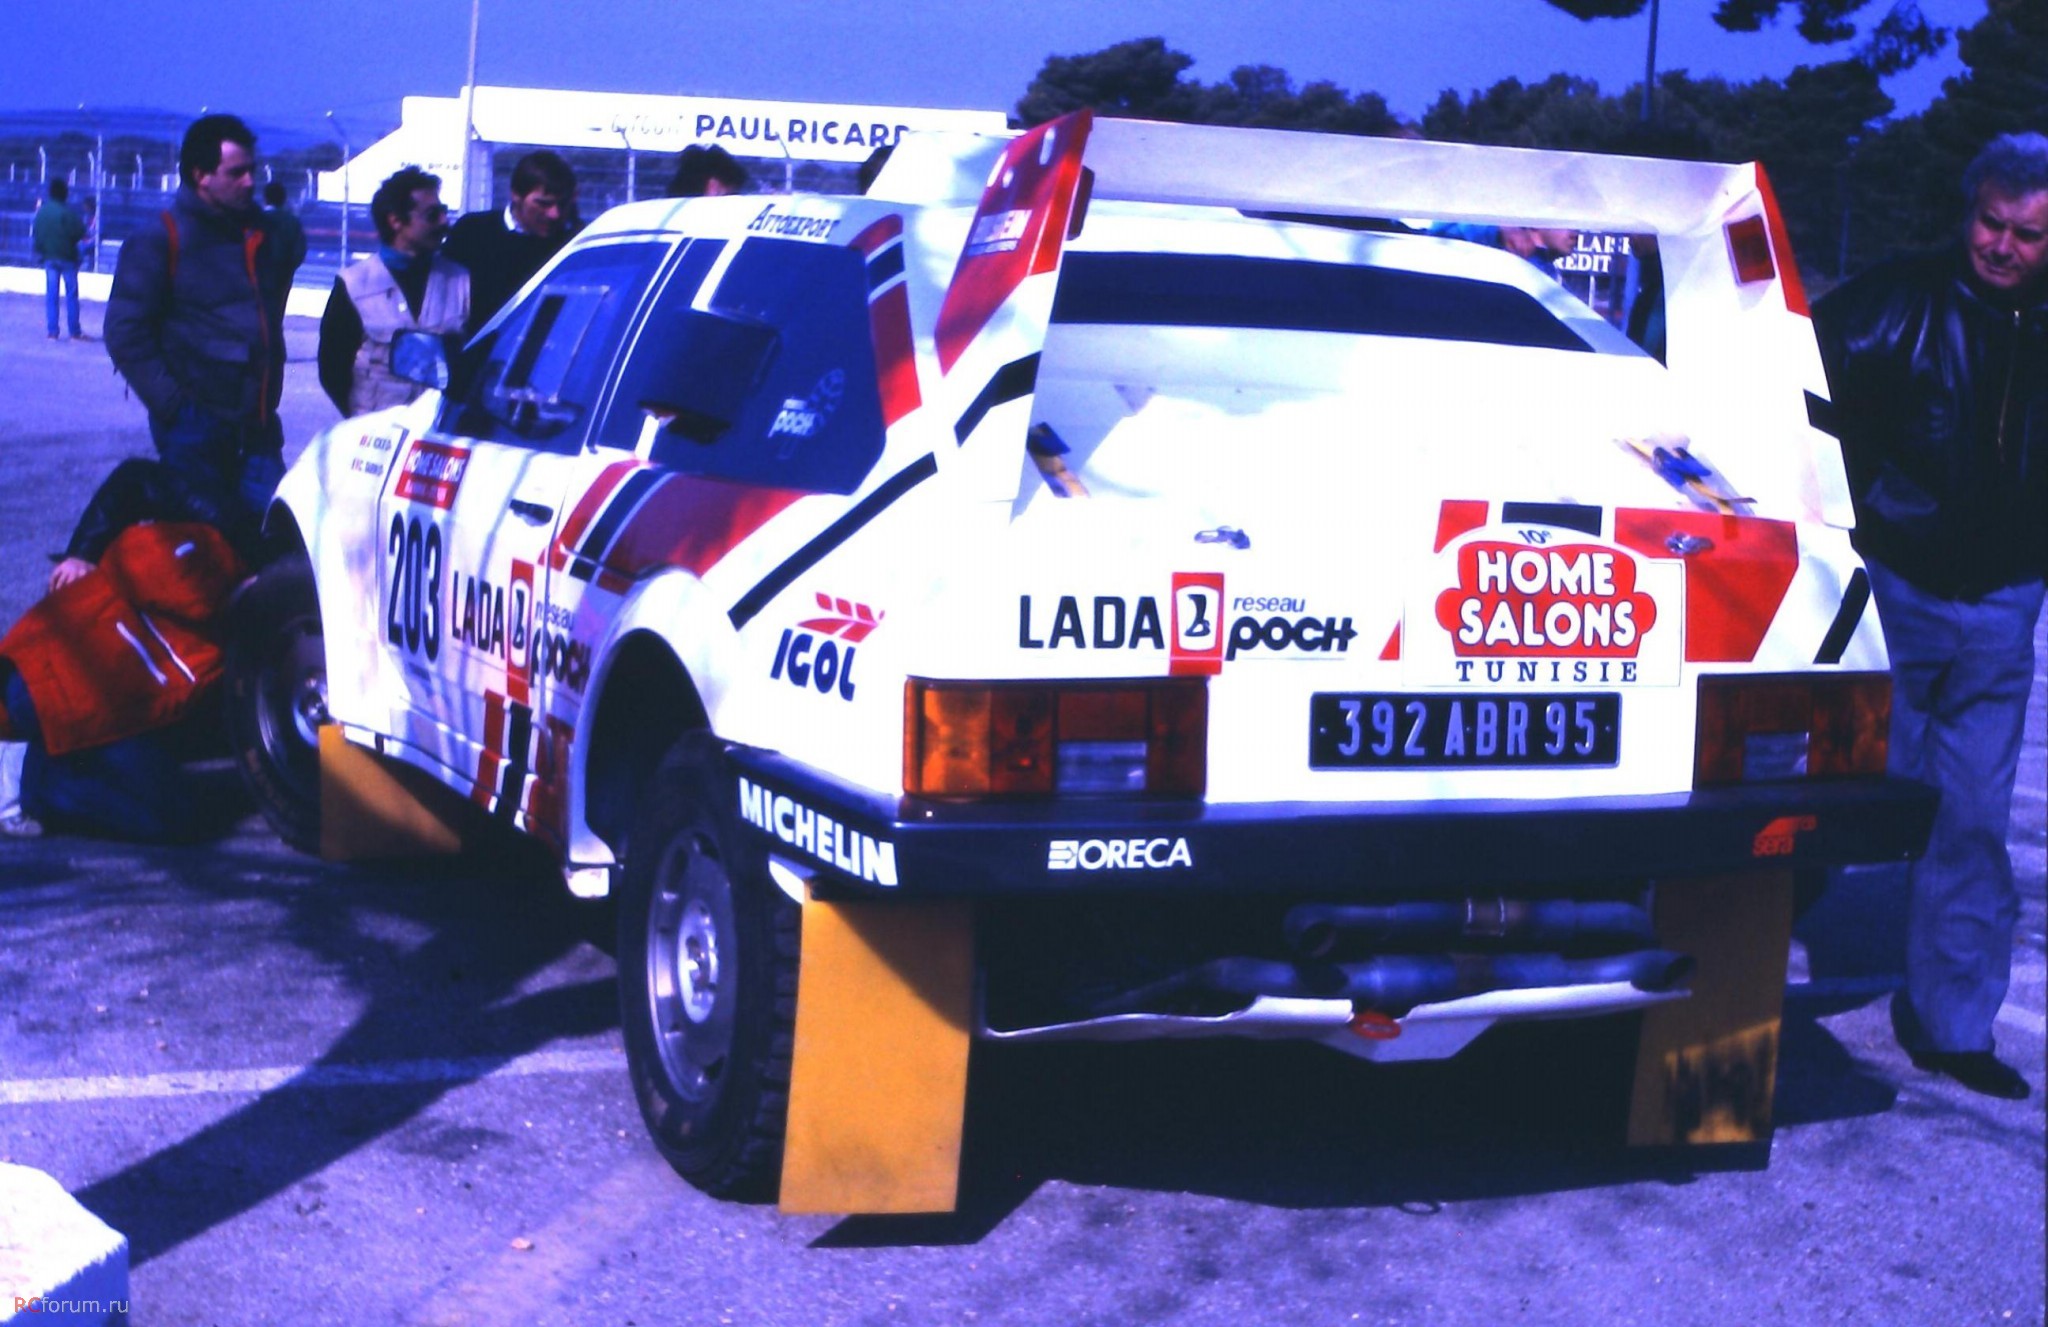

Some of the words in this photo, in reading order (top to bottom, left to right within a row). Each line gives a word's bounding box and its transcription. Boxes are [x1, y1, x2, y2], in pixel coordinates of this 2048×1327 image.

[695, 114, 779, 140] PAUL
[388, 510, 442, 661] 203
[1477, 550, 1616, 596] HOME
[452, 570, 505, 660] LADA
[535, 600, 575, 632] rseau
[1019, 595, 1165, 649] LADA
[1233, 597, 1305, 612] reseau
[1458, 598, 1636, 647] SALONS
[770, 628, 856, 702] IGOL
[1456, 661, 1637, 682] TUNISIE
[1338, 700, 1427, 757] 392
[1444, 701, 1529, 757] ABR
[1544, 701, 1597, 757] 95
[739, 777, 898, 886] MICHELIN
[1078, 838, 1193, 870] ORECA
